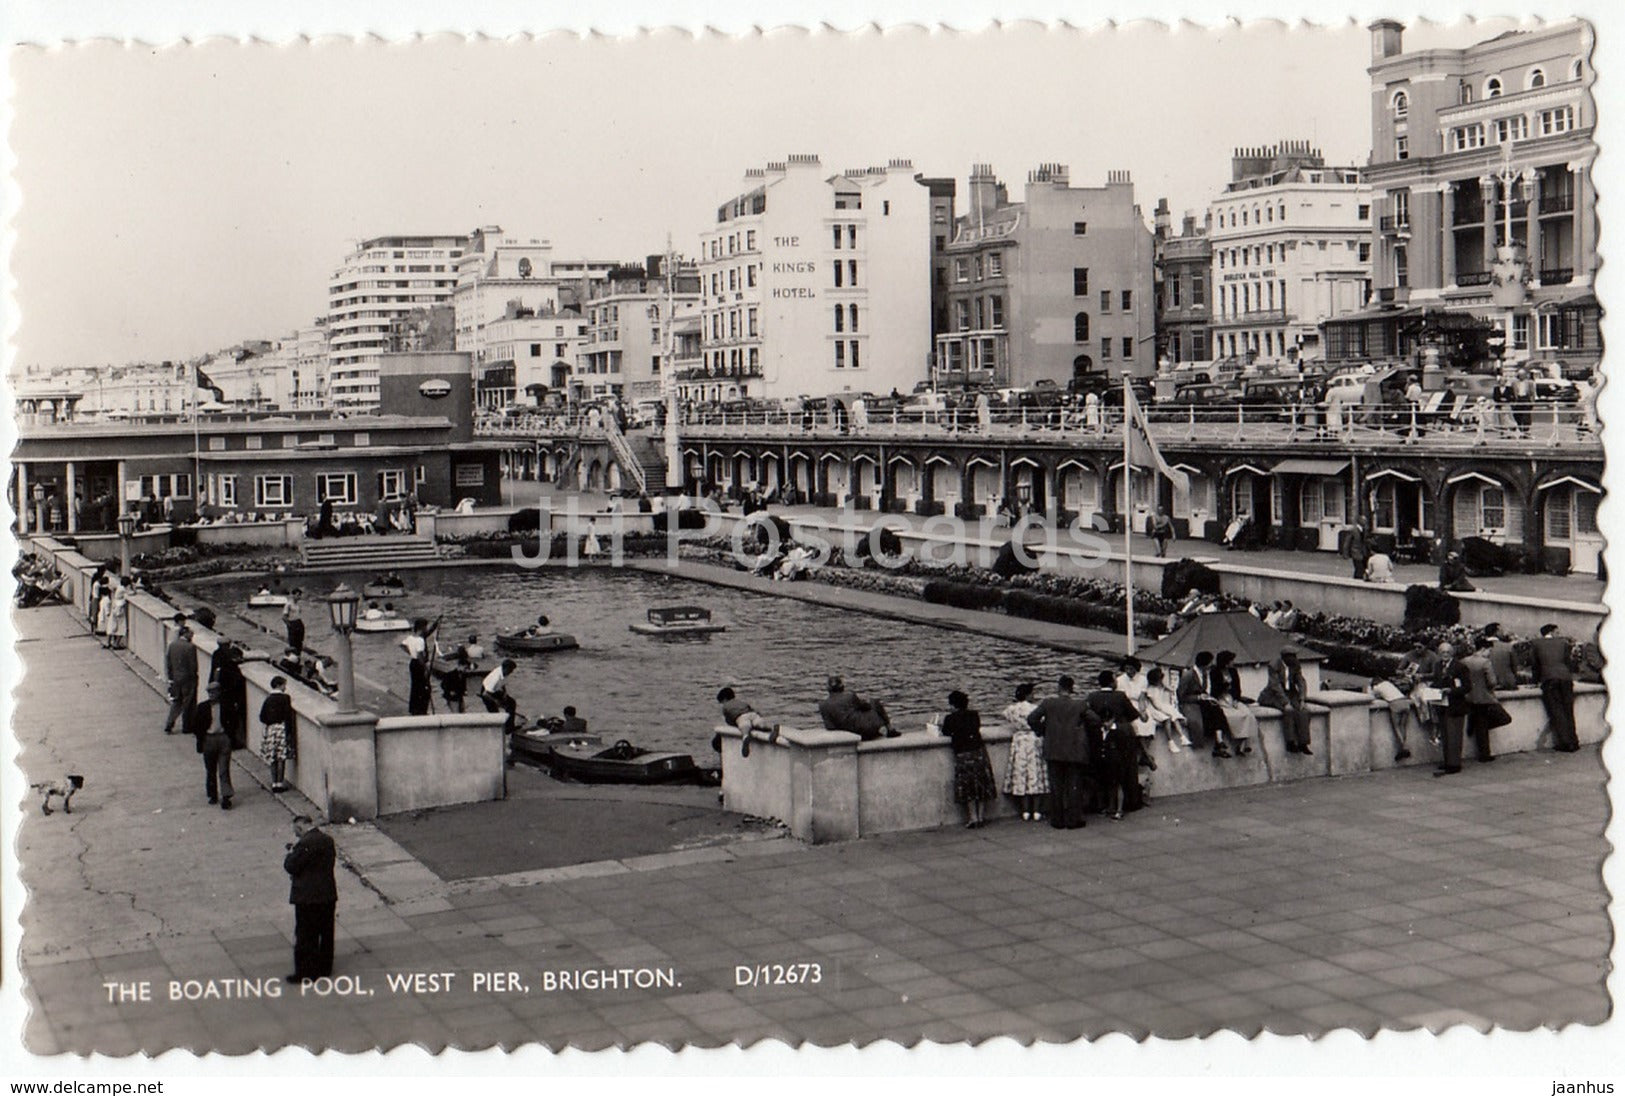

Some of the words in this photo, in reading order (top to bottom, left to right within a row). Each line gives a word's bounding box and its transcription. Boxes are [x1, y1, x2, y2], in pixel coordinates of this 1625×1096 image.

[774, 236, 799, 247] THE
[773, 261, 815, 273] KING'S
[773, 288, 815, 298] HOTEL
